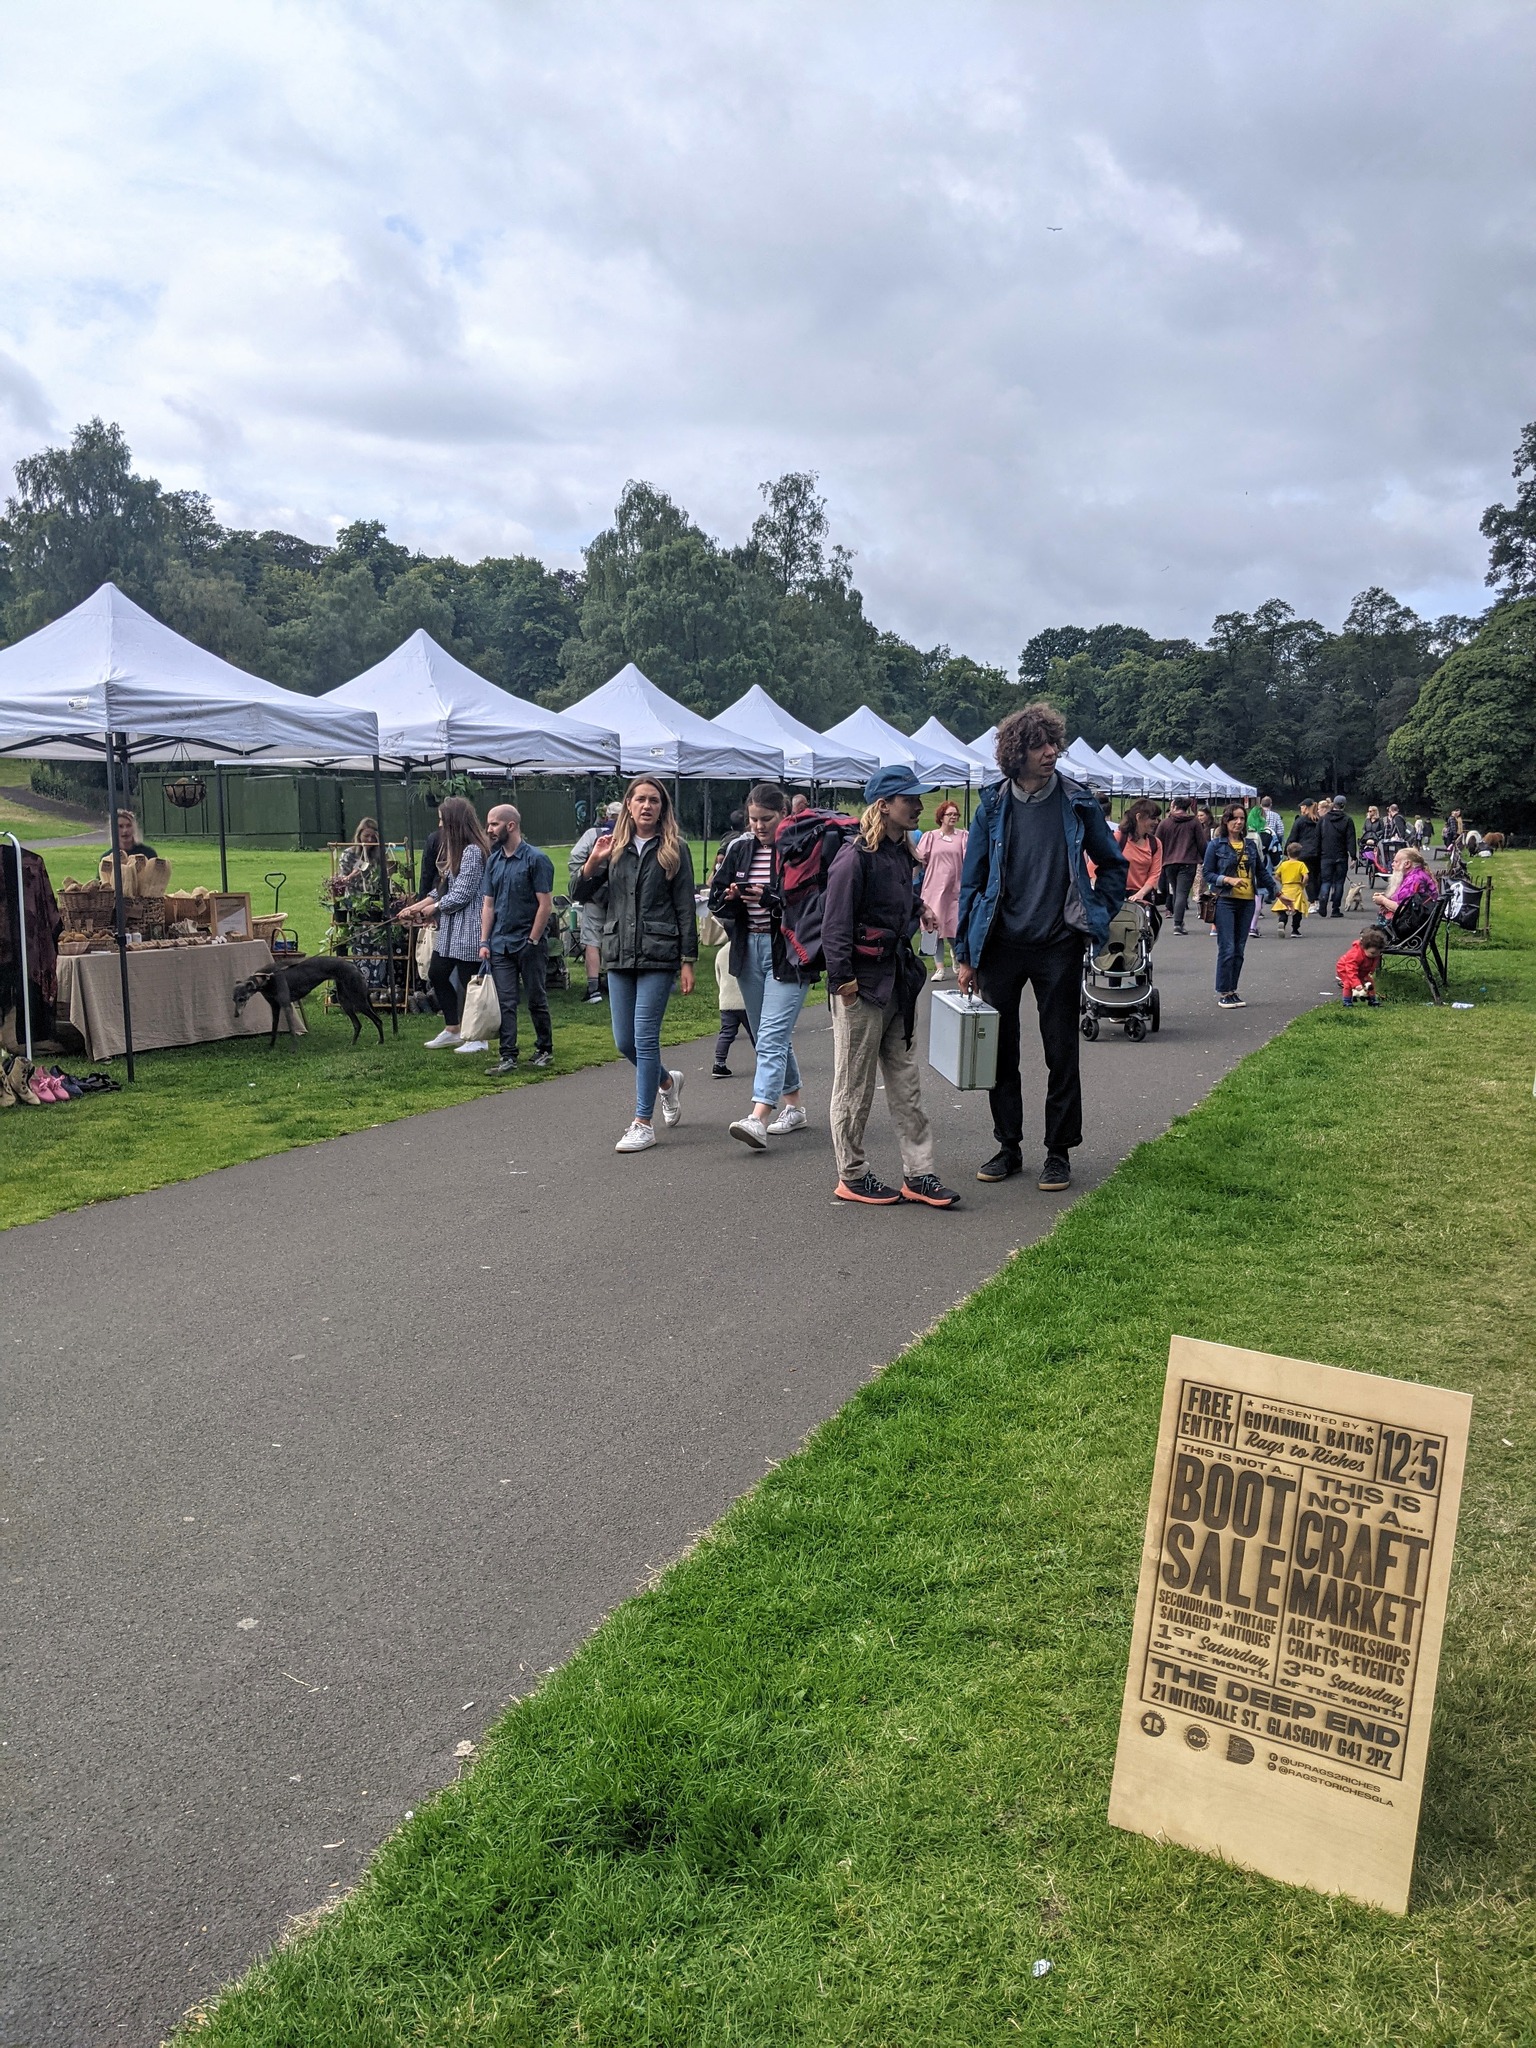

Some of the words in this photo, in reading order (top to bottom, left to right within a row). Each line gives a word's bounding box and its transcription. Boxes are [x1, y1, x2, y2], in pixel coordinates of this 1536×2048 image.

[1187, 1387, 1233, 1420] FREE
[1261, 1403, 1337, 1426] PRESENTED
[1342, 1421, 1359, 1430] BY
[1181, 1412, 1234, 1444] ENTRY
[1243, 1410, 1320, 1444] GOVANHILL
[1326, 1428, 1375, 1455] BATHS
[1181, 1443, 1215, 1458] THIS
[1218, 1452, 1232, 1462] IS
[1235, 1456, 1267, 1470] NOT
[1243, 1430, 1285, 1457] Rags
[1290, 1442, 1309, 1458] to
[1311, 1446, 1365, 1472] Riches
[1381, 1430, 1411, 1485] 12
[1419, 1438, 1440, 1491] 5
[1169, 1453, 1297, 1546] BOOT
[1307, 1491, 1371, 1519] NOT
[1316, 1475, 1384, 1504] THIS
[1393, 1493, 1421, 1513] IS
[1161, 1523, 1287, 1618] SALE
[1295, 1510, 1430, 1598] CRAFT
[1158, 1588, 1223, 1619] SECONDHAND
[1233, 1609, 1277, 1635] VINTAGE
[1160, 1605, 1211, 1632] SALVAGED
[1220, 1622, 1271, 1649] ANTIQUES
[1288, 1568, 1422, 1645] MARKET
[1153, 1641, 1174, 1651] OF
[1177, 1647, 1208, 1662] THE
[1212, 1657, 1270, 1680] MONTH
[1197, 1635, 1270, 1672] Saturday
[1286, 1617, 1314, 1640] ART
[1329, 1627, 1411, 1667] WORKSHOPS
[1286, 1637, 1340, 1668] CRAFTS
[1351, 1655, 1405, 1686] EVENTS
[1151, 1657, 1218, 1695] THE
[1226, 1680, 1317, 1720] DEEP
[1325, 1709, 1401, 1748] END
[1280, 1678, 1302, 1689] OF
[1305, 1685, 1339, 1701] THE
[1342, 1696, 1403, 1720] MONTH
[1327, 1673, 1405, 1710] Saturday
[1151, 1681, 1166, 1701] 21
[1168, 1686, 1239, 1724] NITHSDALE
[1240, 1708, 1261, 1732] ST.
[1266, 1716, 1334, 1752] GLASGOW
[1337, 1737, 1363, 1762] G41
[1365, 1746, 1393, 1771] 2PZ
[1278, 1765, 1394, 1807] @RAGSTORICHESGLA
[1280, 1756, 1381, 1793] @UPRAGS2RICHES
